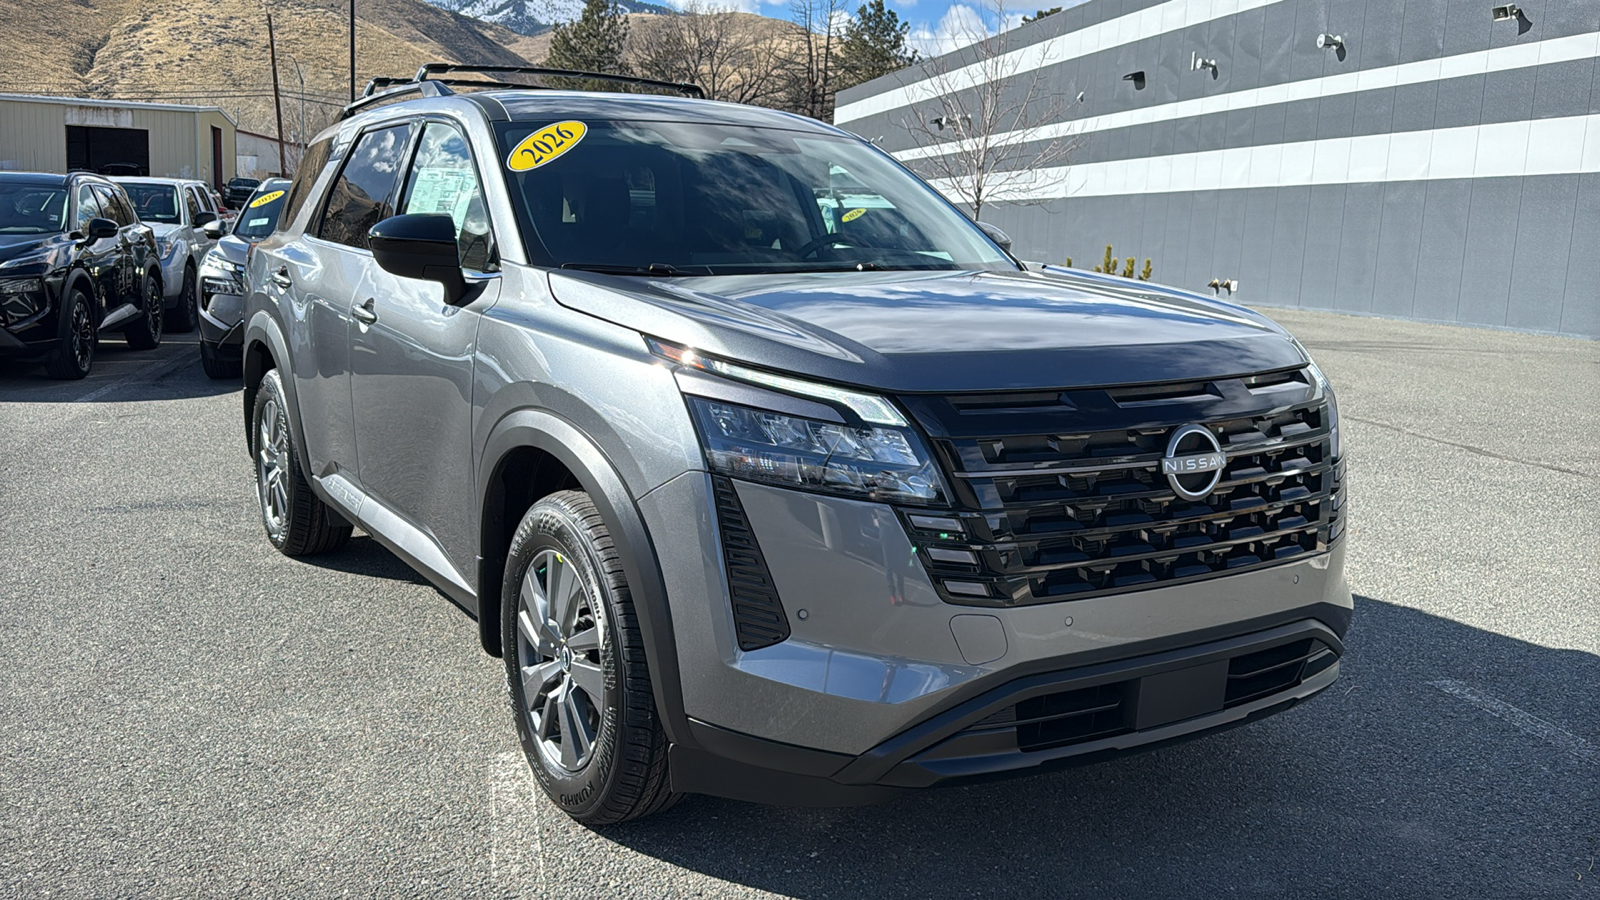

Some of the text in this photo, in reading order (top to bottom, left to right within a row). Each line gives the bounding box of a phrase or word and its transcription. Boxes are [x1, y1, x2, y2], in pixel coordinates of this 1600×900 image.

[520, 124, 574, 165] 2026
[256, 192, 278, 206] 2026
[845, 209, 863, 221] 2026
[1164, 455, 1226, 472] NISSAN
[559, 780, 595, 806] KUMHO
